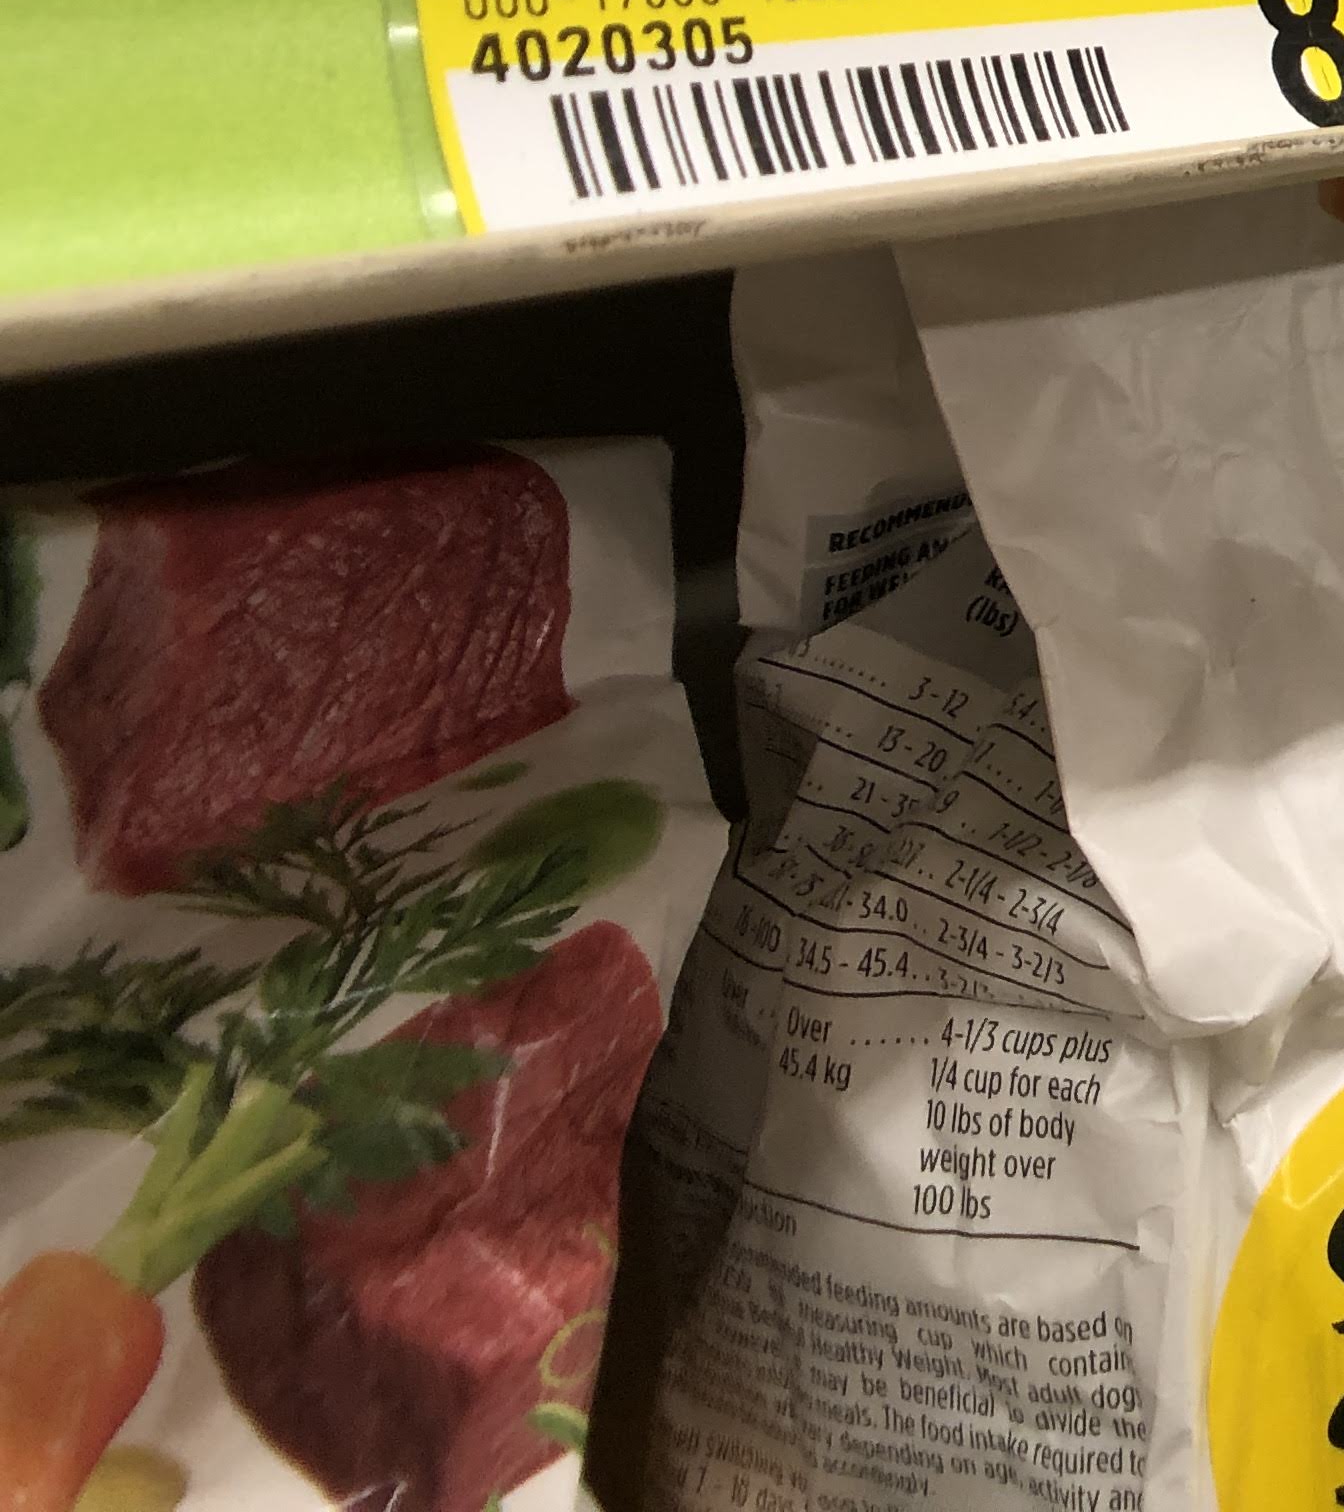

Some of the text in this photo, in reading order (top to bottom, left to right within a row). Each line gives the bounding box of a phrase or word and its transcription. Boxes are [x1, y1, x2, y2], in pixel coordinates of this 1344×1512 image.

[470, 16, 754, 84] 4020305
[824, 546, 912, 596] FEEDING
[965, 595, 1019, 638] (lbs)
[787, 1005, 1112, 1064] Over 4-1/3 cups plus
[778, 1047, 853, 1092] 45.4 kg
[930, 1056, 1101, 1107] 1/4 cup for each
[925, 1098, 1075, 1147] 10 lbs of body
[919, 1146, 1056, 1181] weight over
[912, 1182, 992, 1221] 100 lbs
[825, 1273, 1134, 1346] feeding amounts are based on
[916, 1326, 954, 1352] cup
[970, 1336, 1028, 1373] which
[860, 1370, 887, 1398] be
[899, 1376, 996, 1419] beneficial
[1035, 1407, 1101, 1438] divide
[1112, 1416, 1147, 1443] the
[883, 1403, 1123, 1478] The food intake required
[950, 1457, 977, 1477] on
